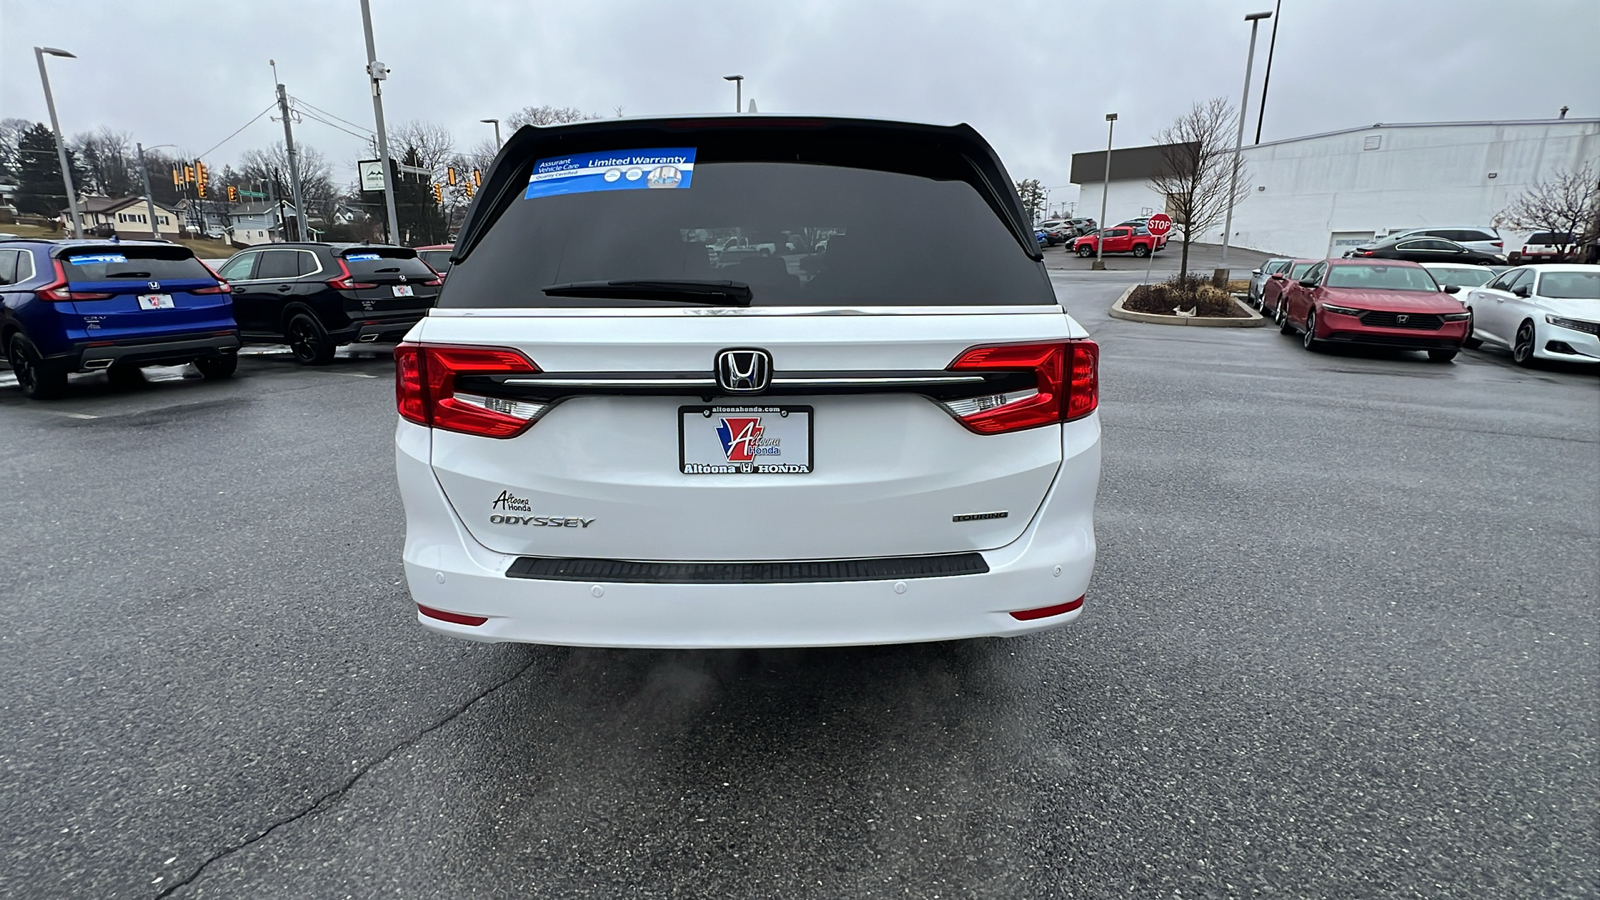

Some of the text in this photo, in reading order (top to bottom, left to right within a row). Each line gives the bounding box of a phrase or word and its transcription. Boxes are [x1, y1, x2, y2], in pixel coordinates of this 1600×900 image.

[539, 159, 571, 168] Assurant
[588, 156, 686, 167] Limited Warranty
[538, 165, 562, 173] Vehicle
[1148, 220, 1171, 230] STOP
[727, 421, 780, 456] Altoona
[748, 446, 780, 455] Honda
[684, 464, 809, 473] Altoona HONDA
[508, 504, 531, 512] Honda
[490, 514, 596, 528] ODYSSEY
[953, 511, 1008, 522] TOURING
